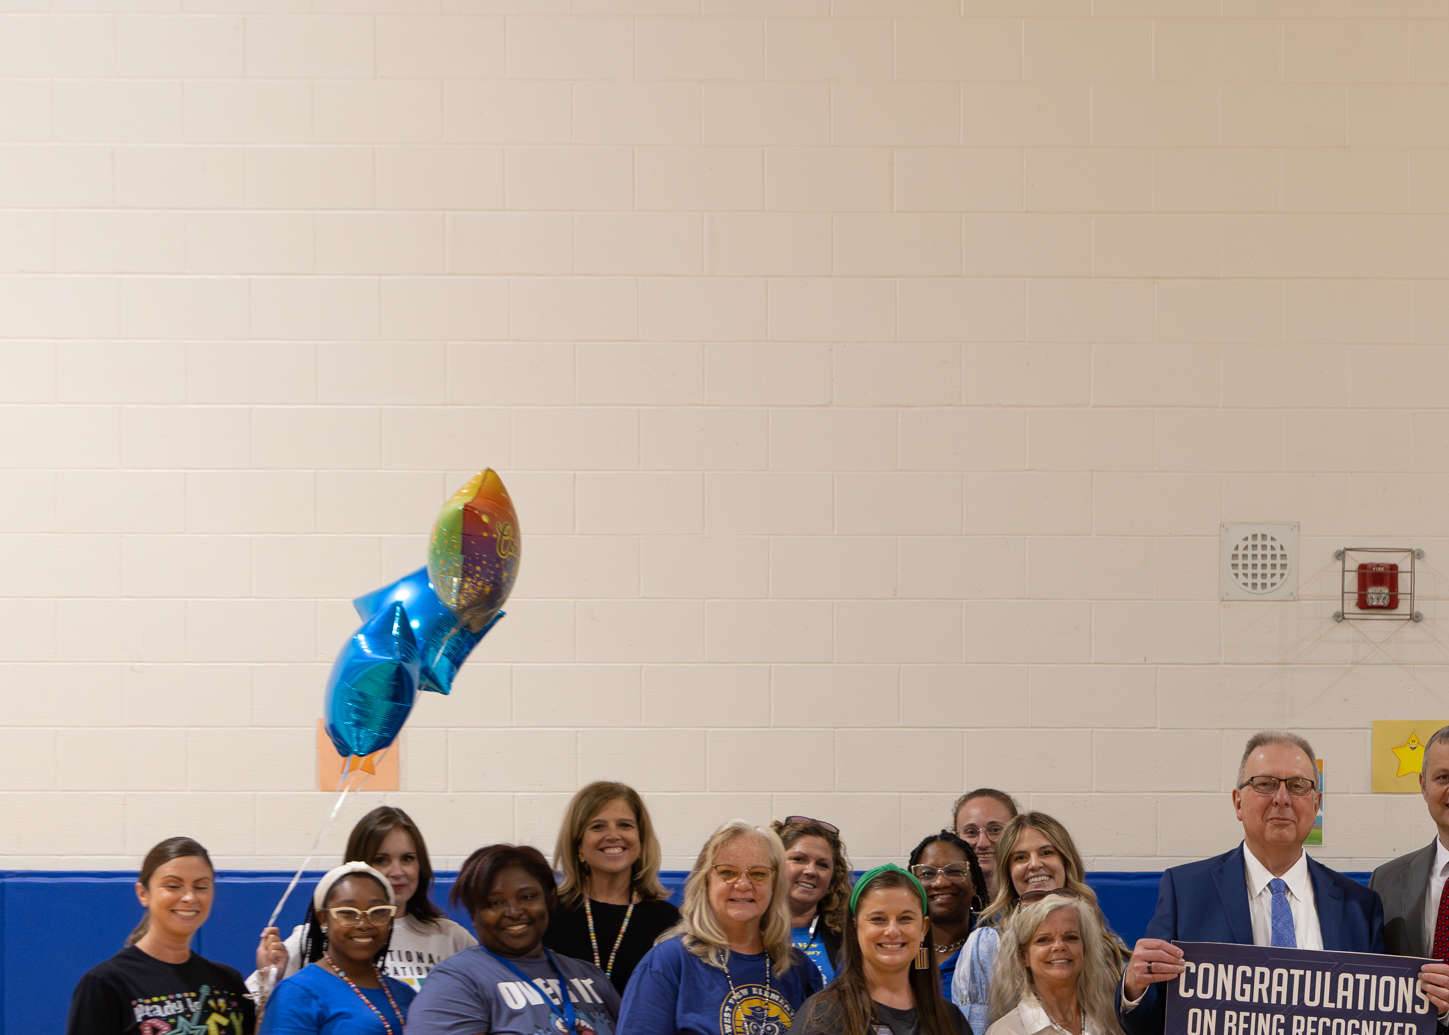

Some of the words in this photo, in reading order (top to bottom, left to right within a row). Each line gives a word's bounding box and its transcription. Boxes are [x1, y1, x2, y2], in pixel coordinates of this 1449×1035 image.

[569, 977, 604, 1004] IT
[1177, 961, 1431, 1015] CONGRATULATIONS
[723, 1005, 732, 1033] WEST
